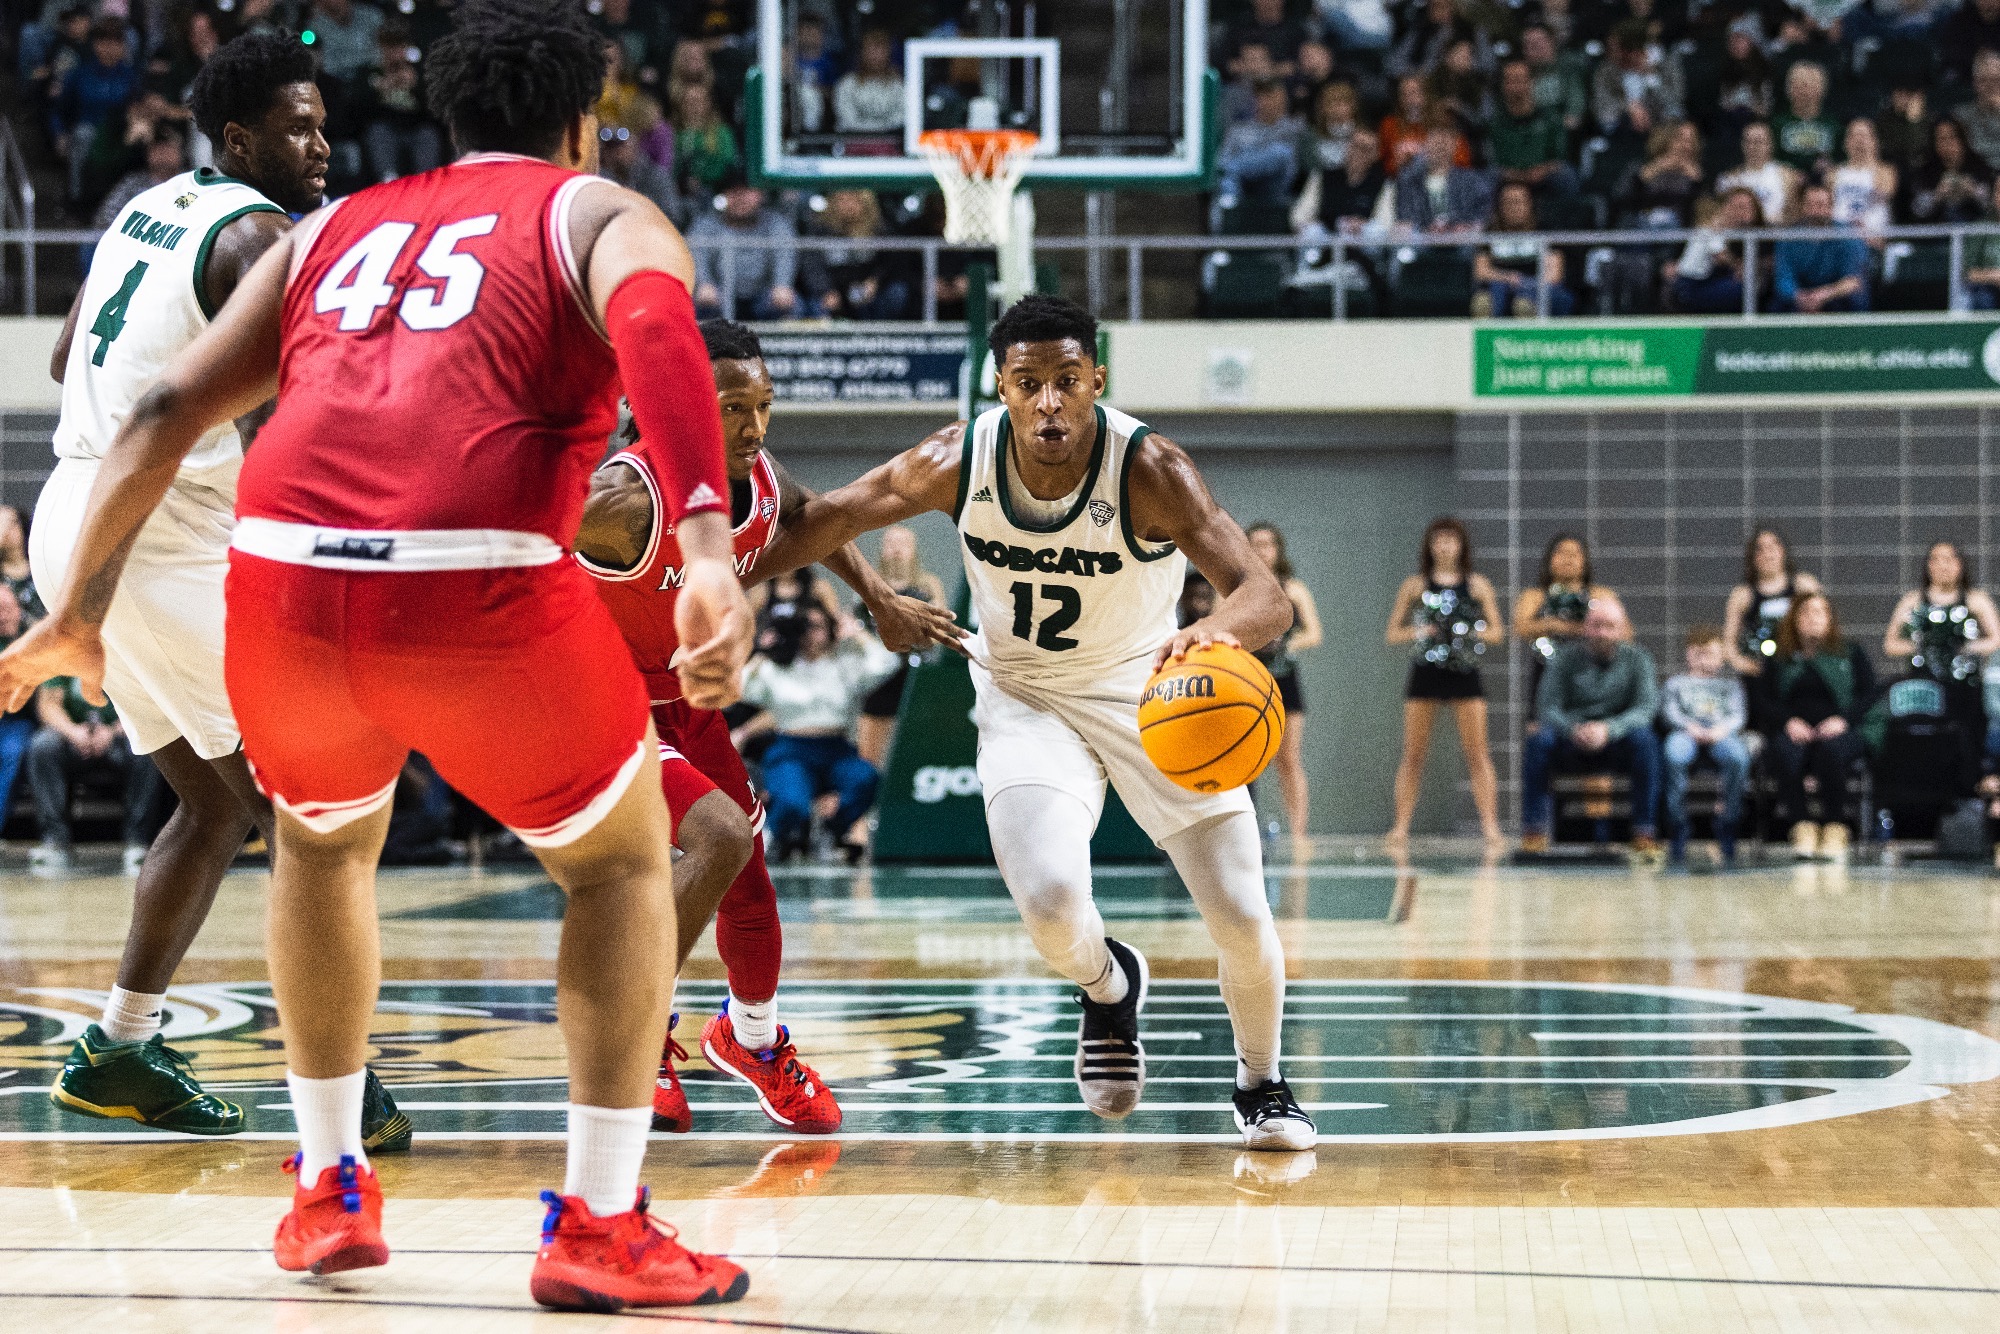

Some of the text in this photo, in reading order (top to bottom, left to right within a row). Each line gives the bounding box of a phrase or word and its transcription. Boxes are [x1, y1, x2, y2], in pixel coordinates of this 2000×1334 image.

[314, 212, 500, 332] 45
[89, 259, 149, 368] 4
[1090, 507, 1114, 519] MAC
[964, 531, 1123, 577] BOBCATS
[1009, 581, 1082, 652] 12
[1139, 674, 1216, 709] Wilson
[912, 766, 983, 803] go
